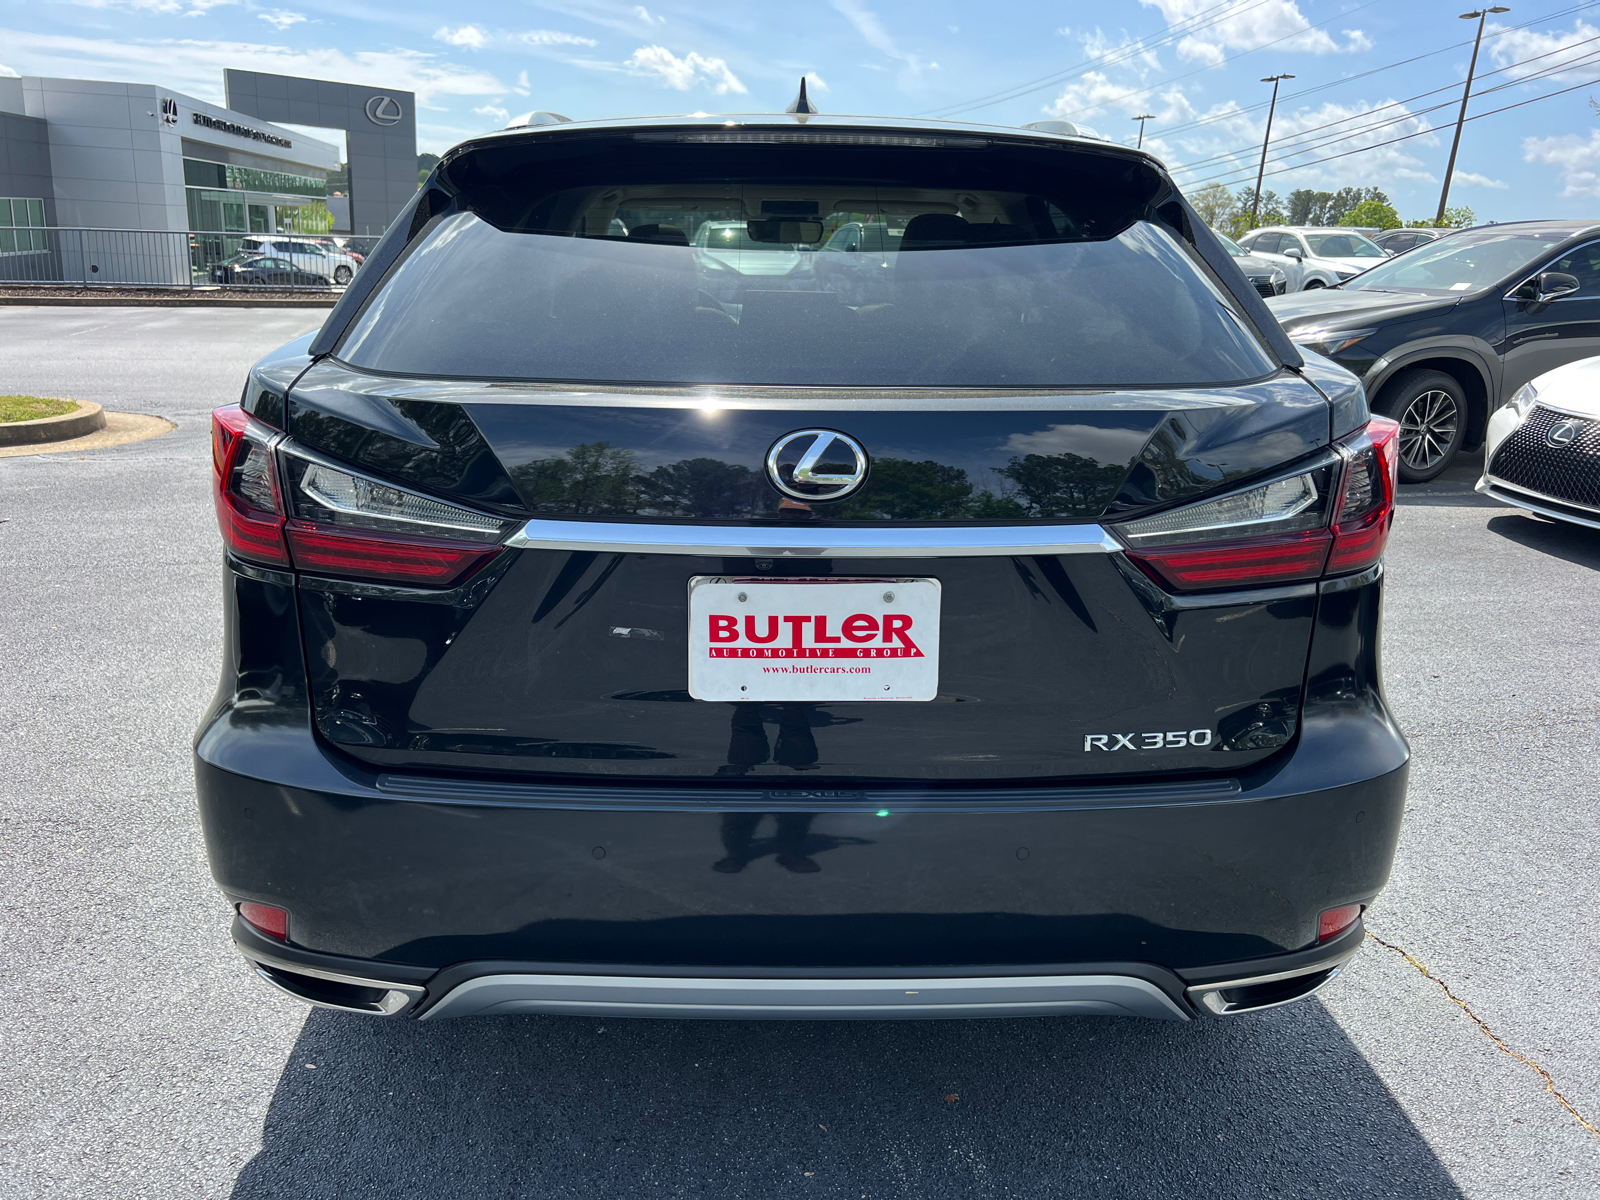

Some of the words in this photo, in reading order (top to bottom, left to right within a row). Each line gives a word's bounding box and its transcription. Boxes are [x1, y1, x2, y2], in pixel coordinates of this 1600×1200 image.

[710, 648, 835, 658] AUTOMOTIVE
[856, 647, 918, 657] GROUP
[762, 665, 871, 674] www.butlercars.com
[1084, 732, 1137, 752] RX
[1141, 728, 1212, 750] 350
